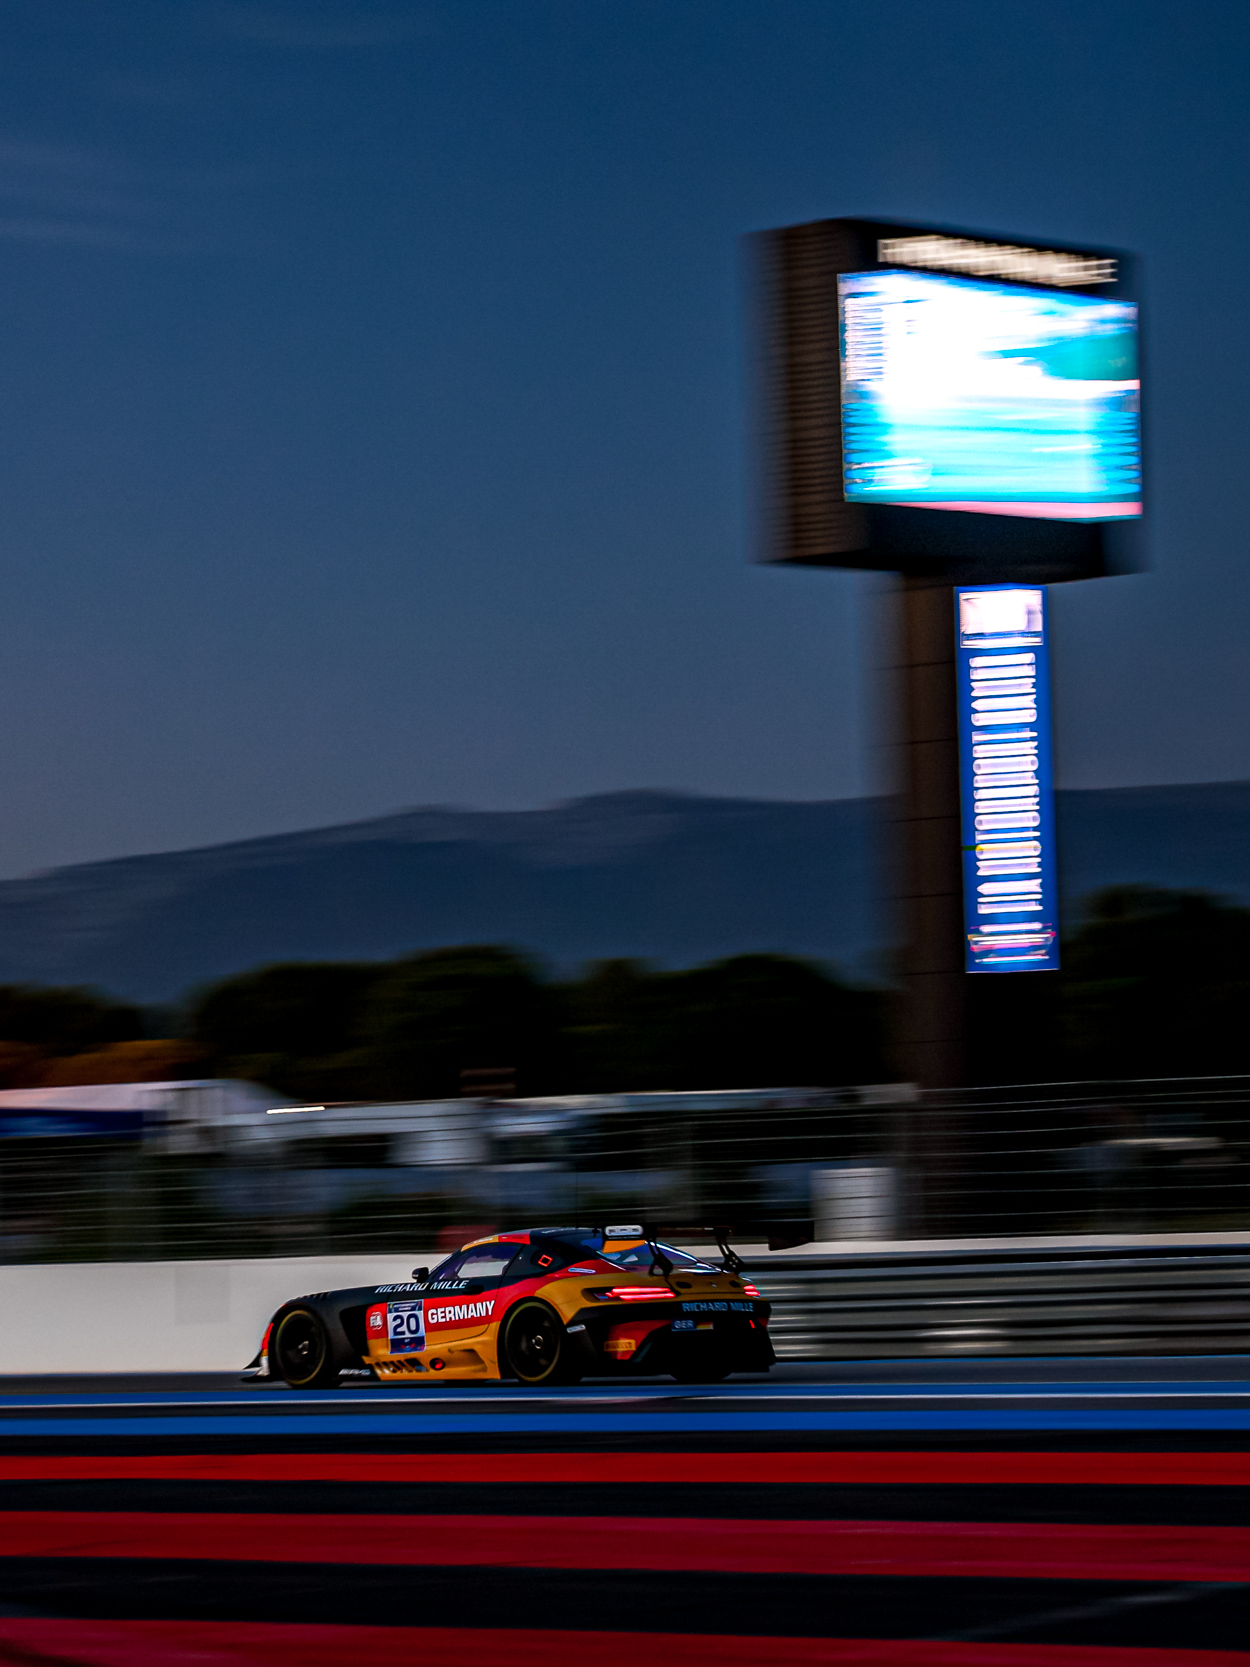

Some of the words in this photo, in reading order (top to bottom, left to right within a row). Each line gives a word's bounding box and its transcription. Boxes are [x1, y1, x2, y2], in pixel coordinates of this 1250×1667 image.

[374, 1282, 428, 1294] RICHARD
[430, 1280, 469, 1290] MILLE
[428, 1300, 495, 1324] GERMANY
[682, 1302, 728, 1312] RICHARD
[730, 1301, 754, 1312] MILLE
[392, 1313, 420, 1336] 20
[674, 1319, 694, 1329] GER
